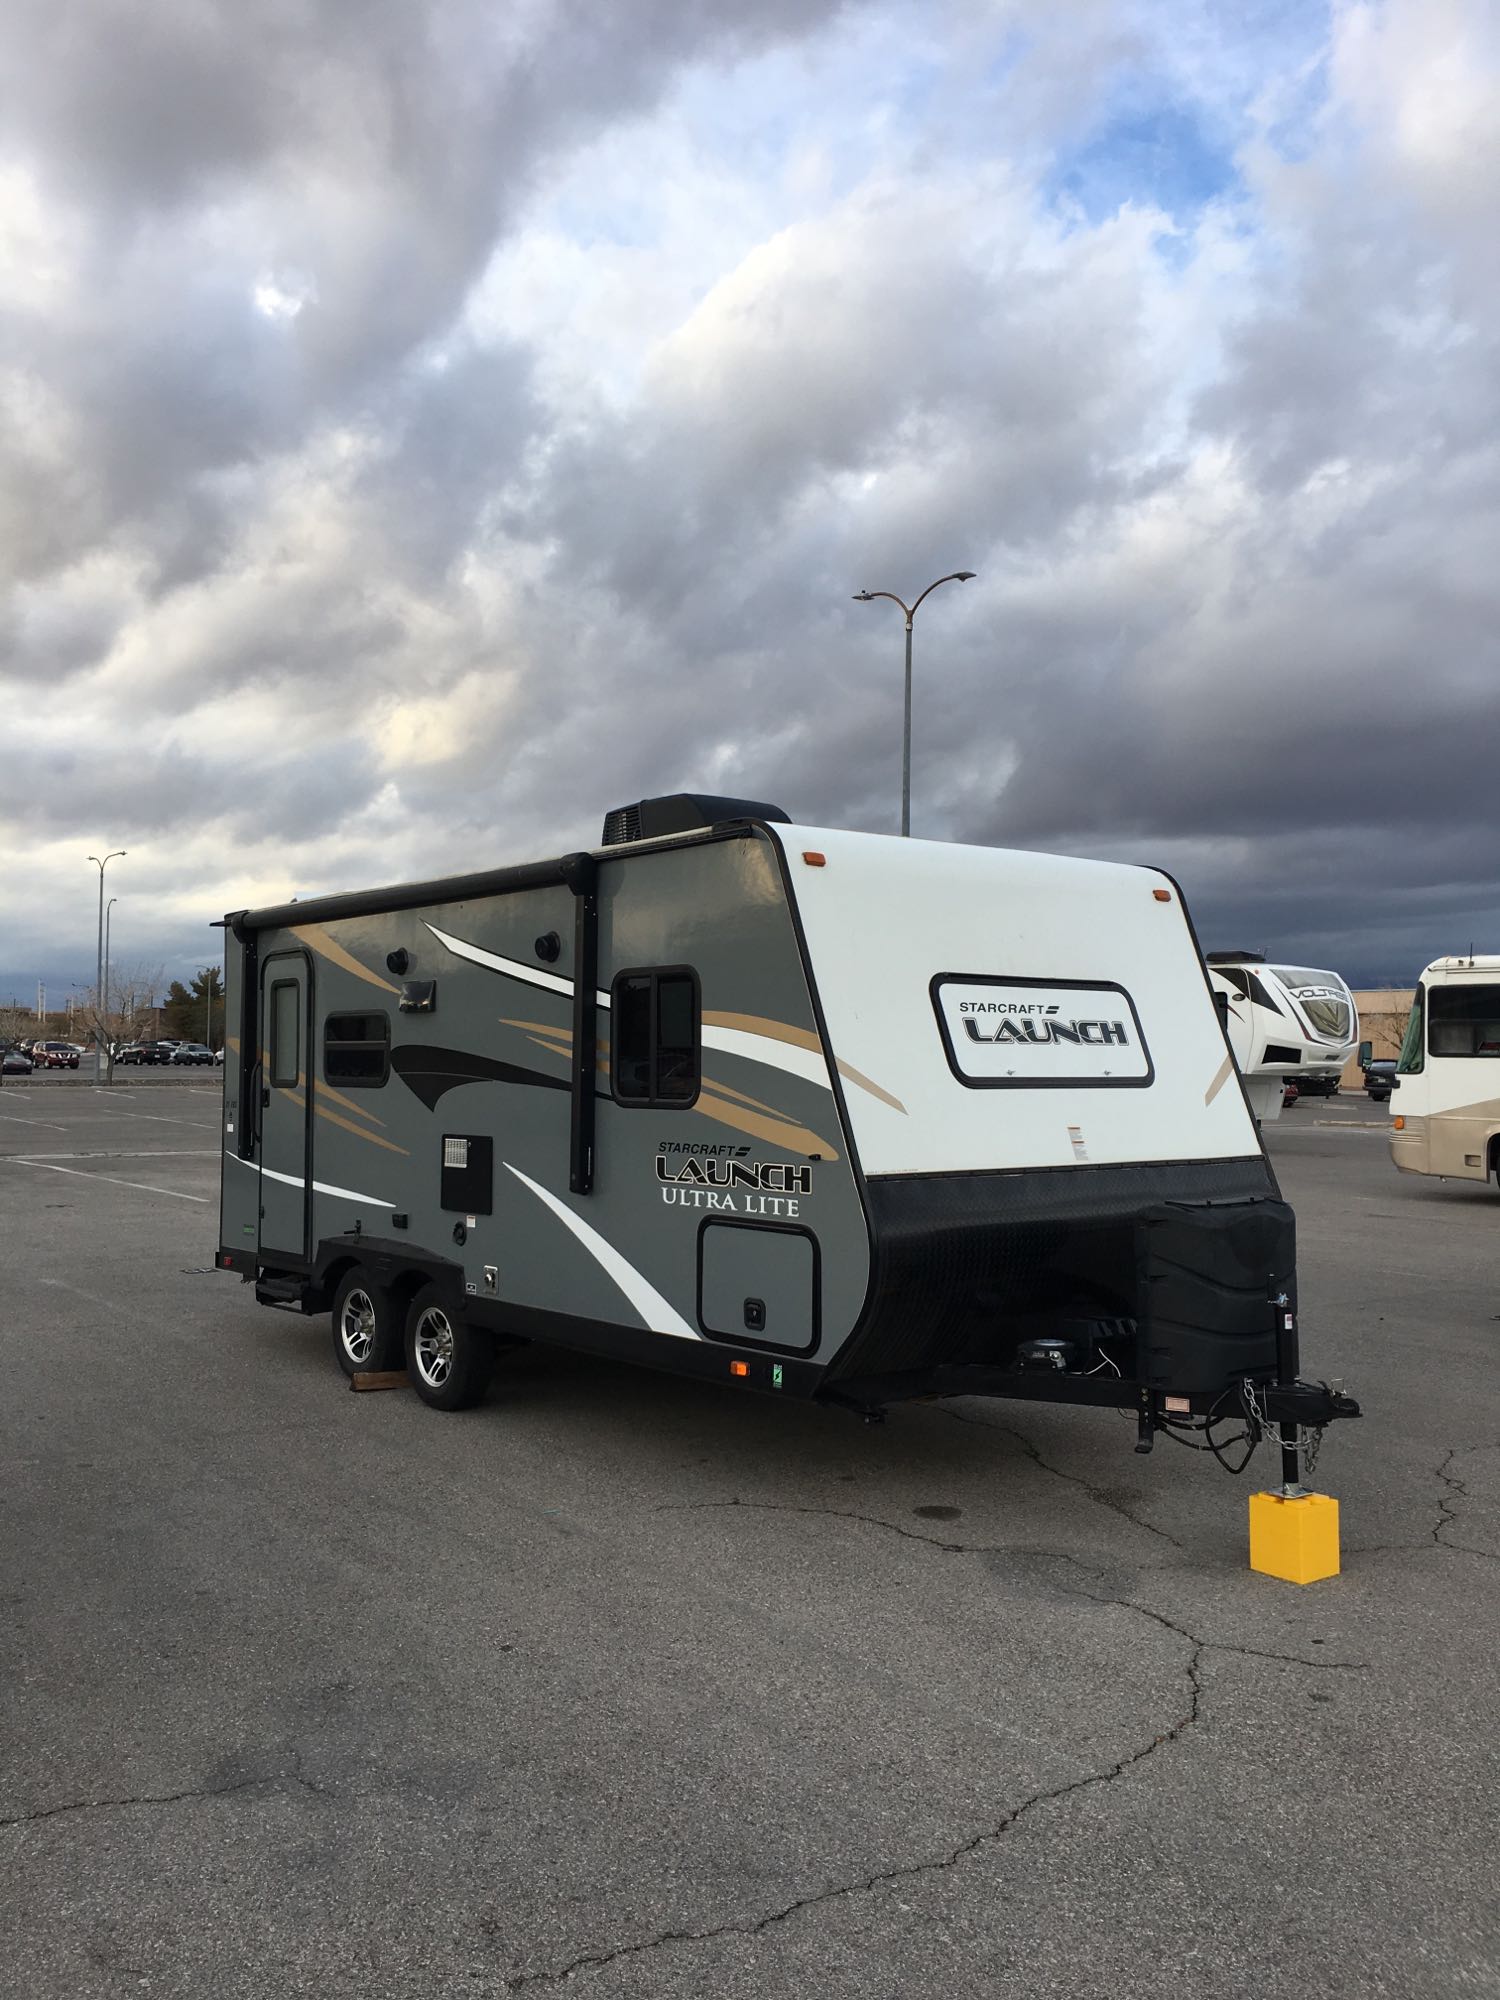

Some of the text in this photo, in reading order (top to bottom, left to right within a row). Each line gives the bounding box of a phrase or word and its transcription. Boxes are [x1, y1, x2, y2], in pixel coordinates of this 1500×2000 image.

[959, 1002, 1044, 1014] STARCRAFT
[962, 1017, 1129, 1046] LAUNCH
[658, 1142, 735, 1157] STARCRAFT
[656, 1155, 812, 1195] LAUNCH
[661, 1187, 800, 1217] ULTRA LITE
